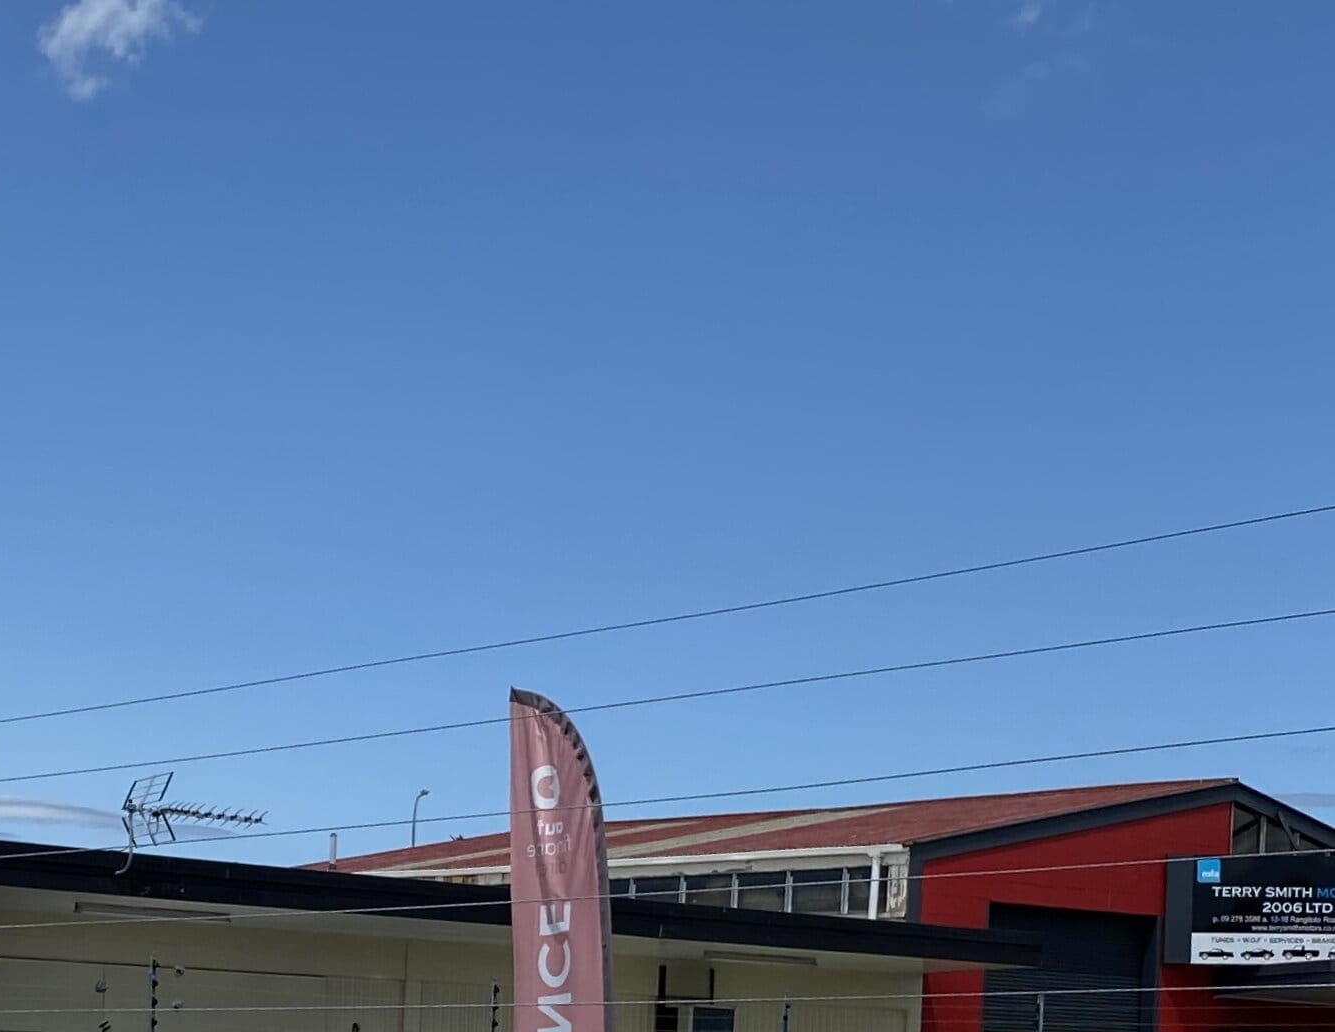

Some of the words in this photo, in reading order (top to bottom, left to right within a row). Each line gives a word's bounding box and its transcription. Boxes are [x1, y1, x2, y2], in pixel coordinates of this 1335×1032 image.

[1212, 886, 1262, 898] TERRY
[1265, 886, 1313, 898] SMITH
[1262, 902, 1303, 913] 2006
[1305, 902, 1333, 914] LTD
